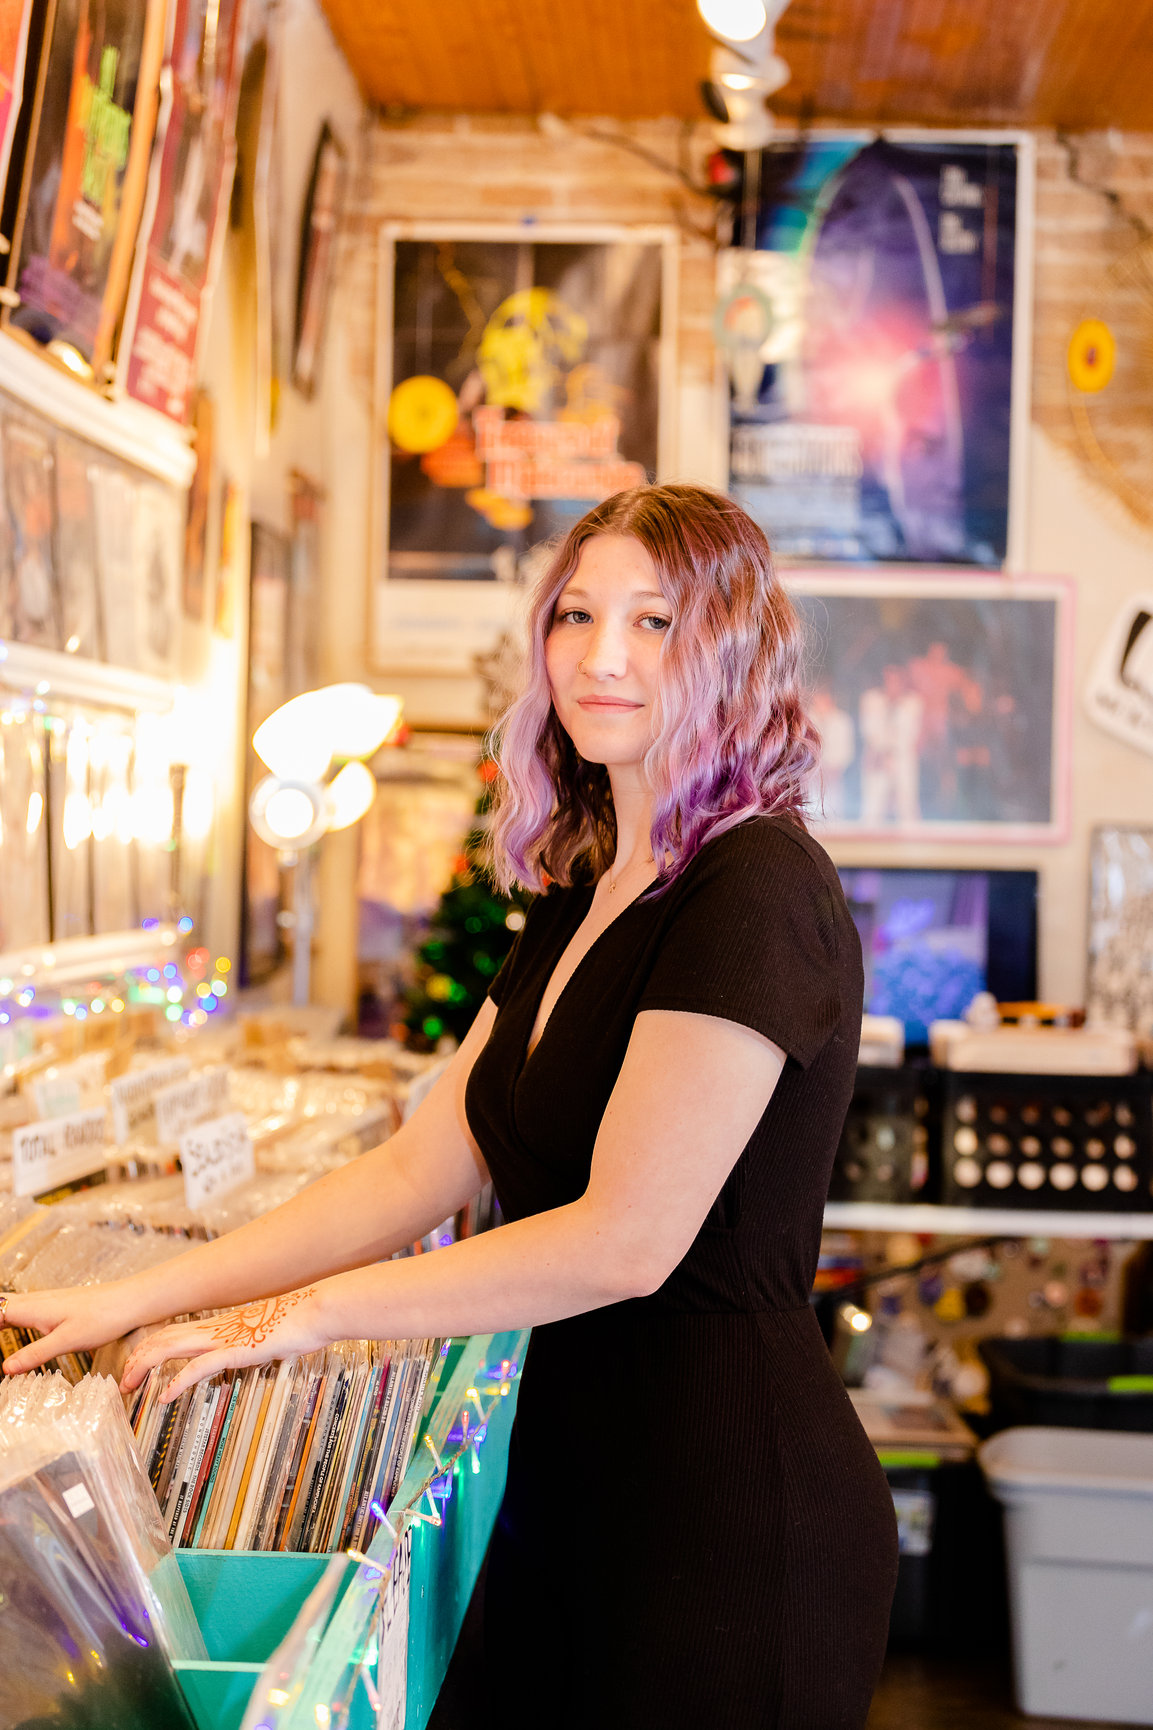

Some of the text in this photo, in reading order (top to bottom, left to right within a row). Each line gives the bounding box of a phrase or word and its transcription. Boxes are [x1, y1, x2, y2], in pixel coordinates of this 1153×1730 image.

[329, 1413, 340, 1439] CONCERTS
[188, 1416, 206, 1471] MONOPHONIC
[194, 1451, 204, 1471] RECORDS
[320, 1458, 329, 1476] PEOPLE
[209, 1465, 218, 1484] SOUNDS
[318, 1476, 324, 1484] OF
[359, 1490, 370, 1515] ATLANTIC
